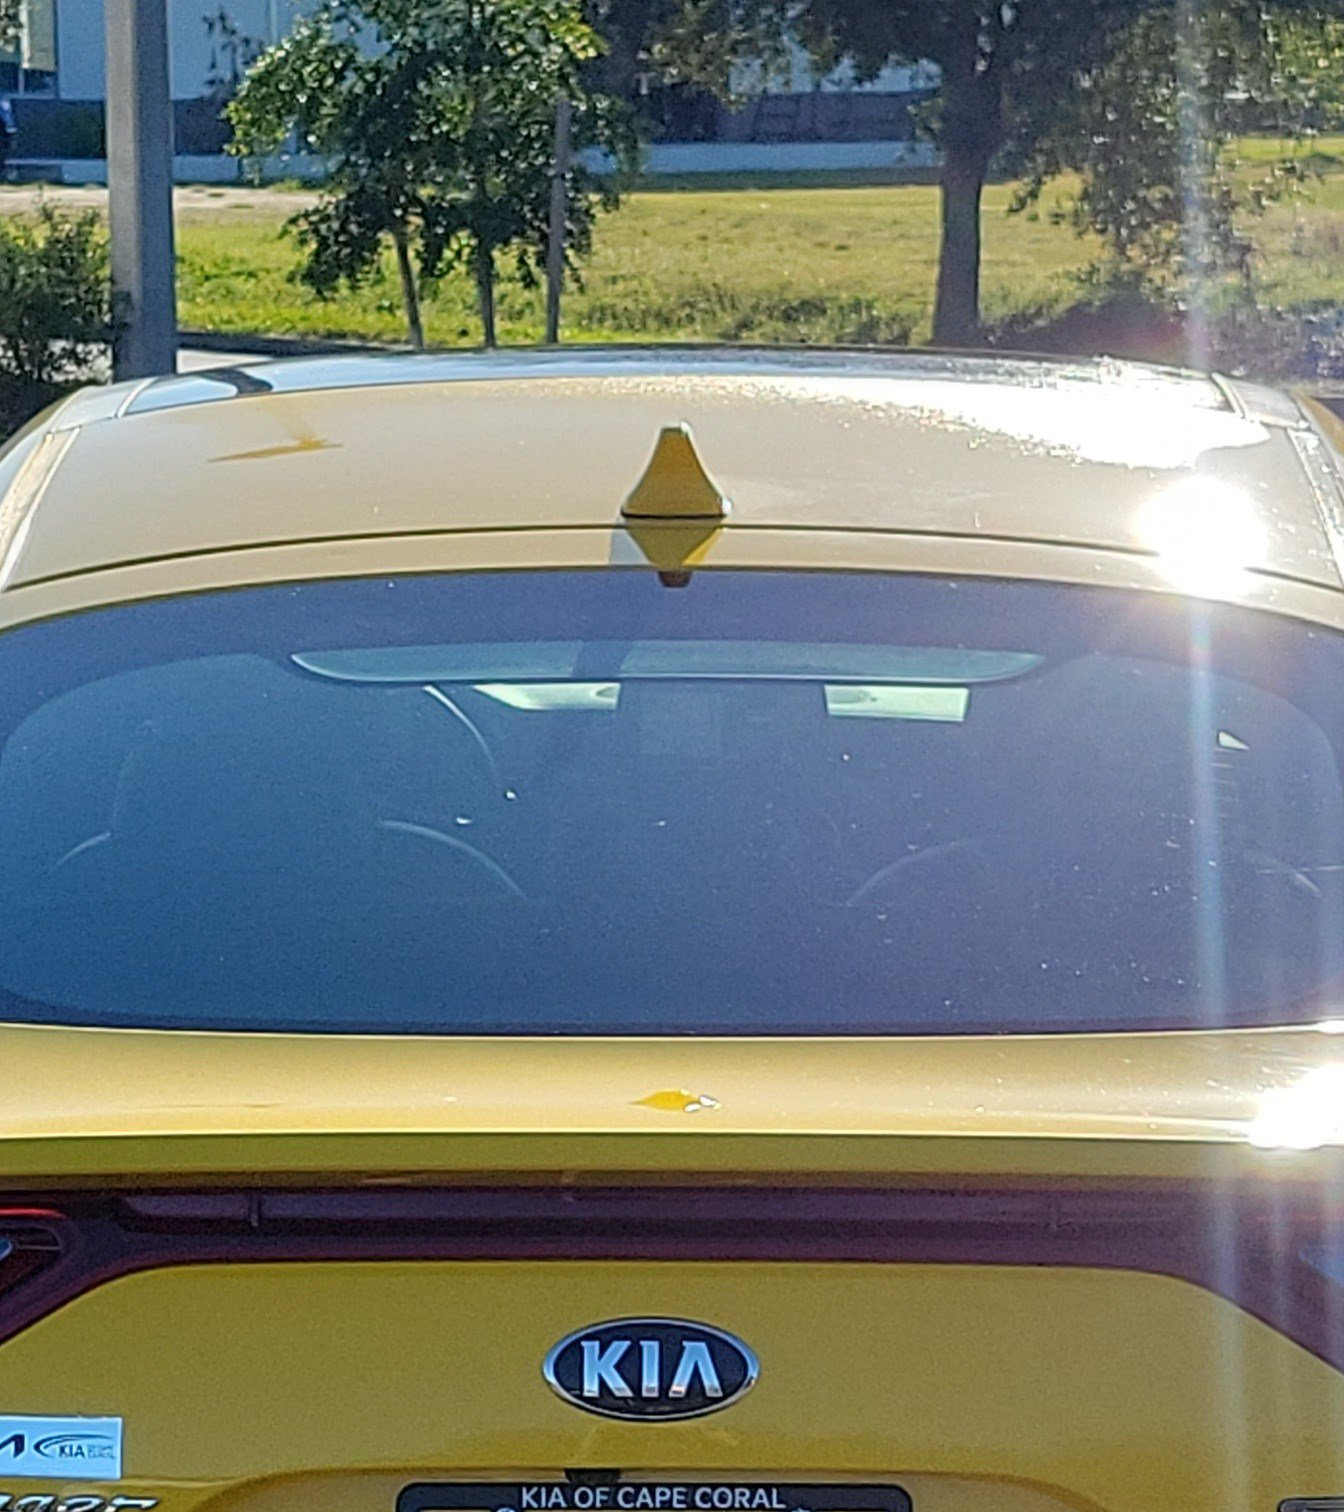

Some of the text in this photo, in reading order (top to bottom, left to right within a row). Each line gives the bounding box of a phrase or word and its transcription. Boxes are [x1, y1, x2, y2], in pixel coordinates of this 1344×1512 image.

[579, 1339, 725, 1398] KIA
[58, 1444, 86, 1459] KIA
[521, 1486, 787, 1510] KIA OF CAPE CORAL
